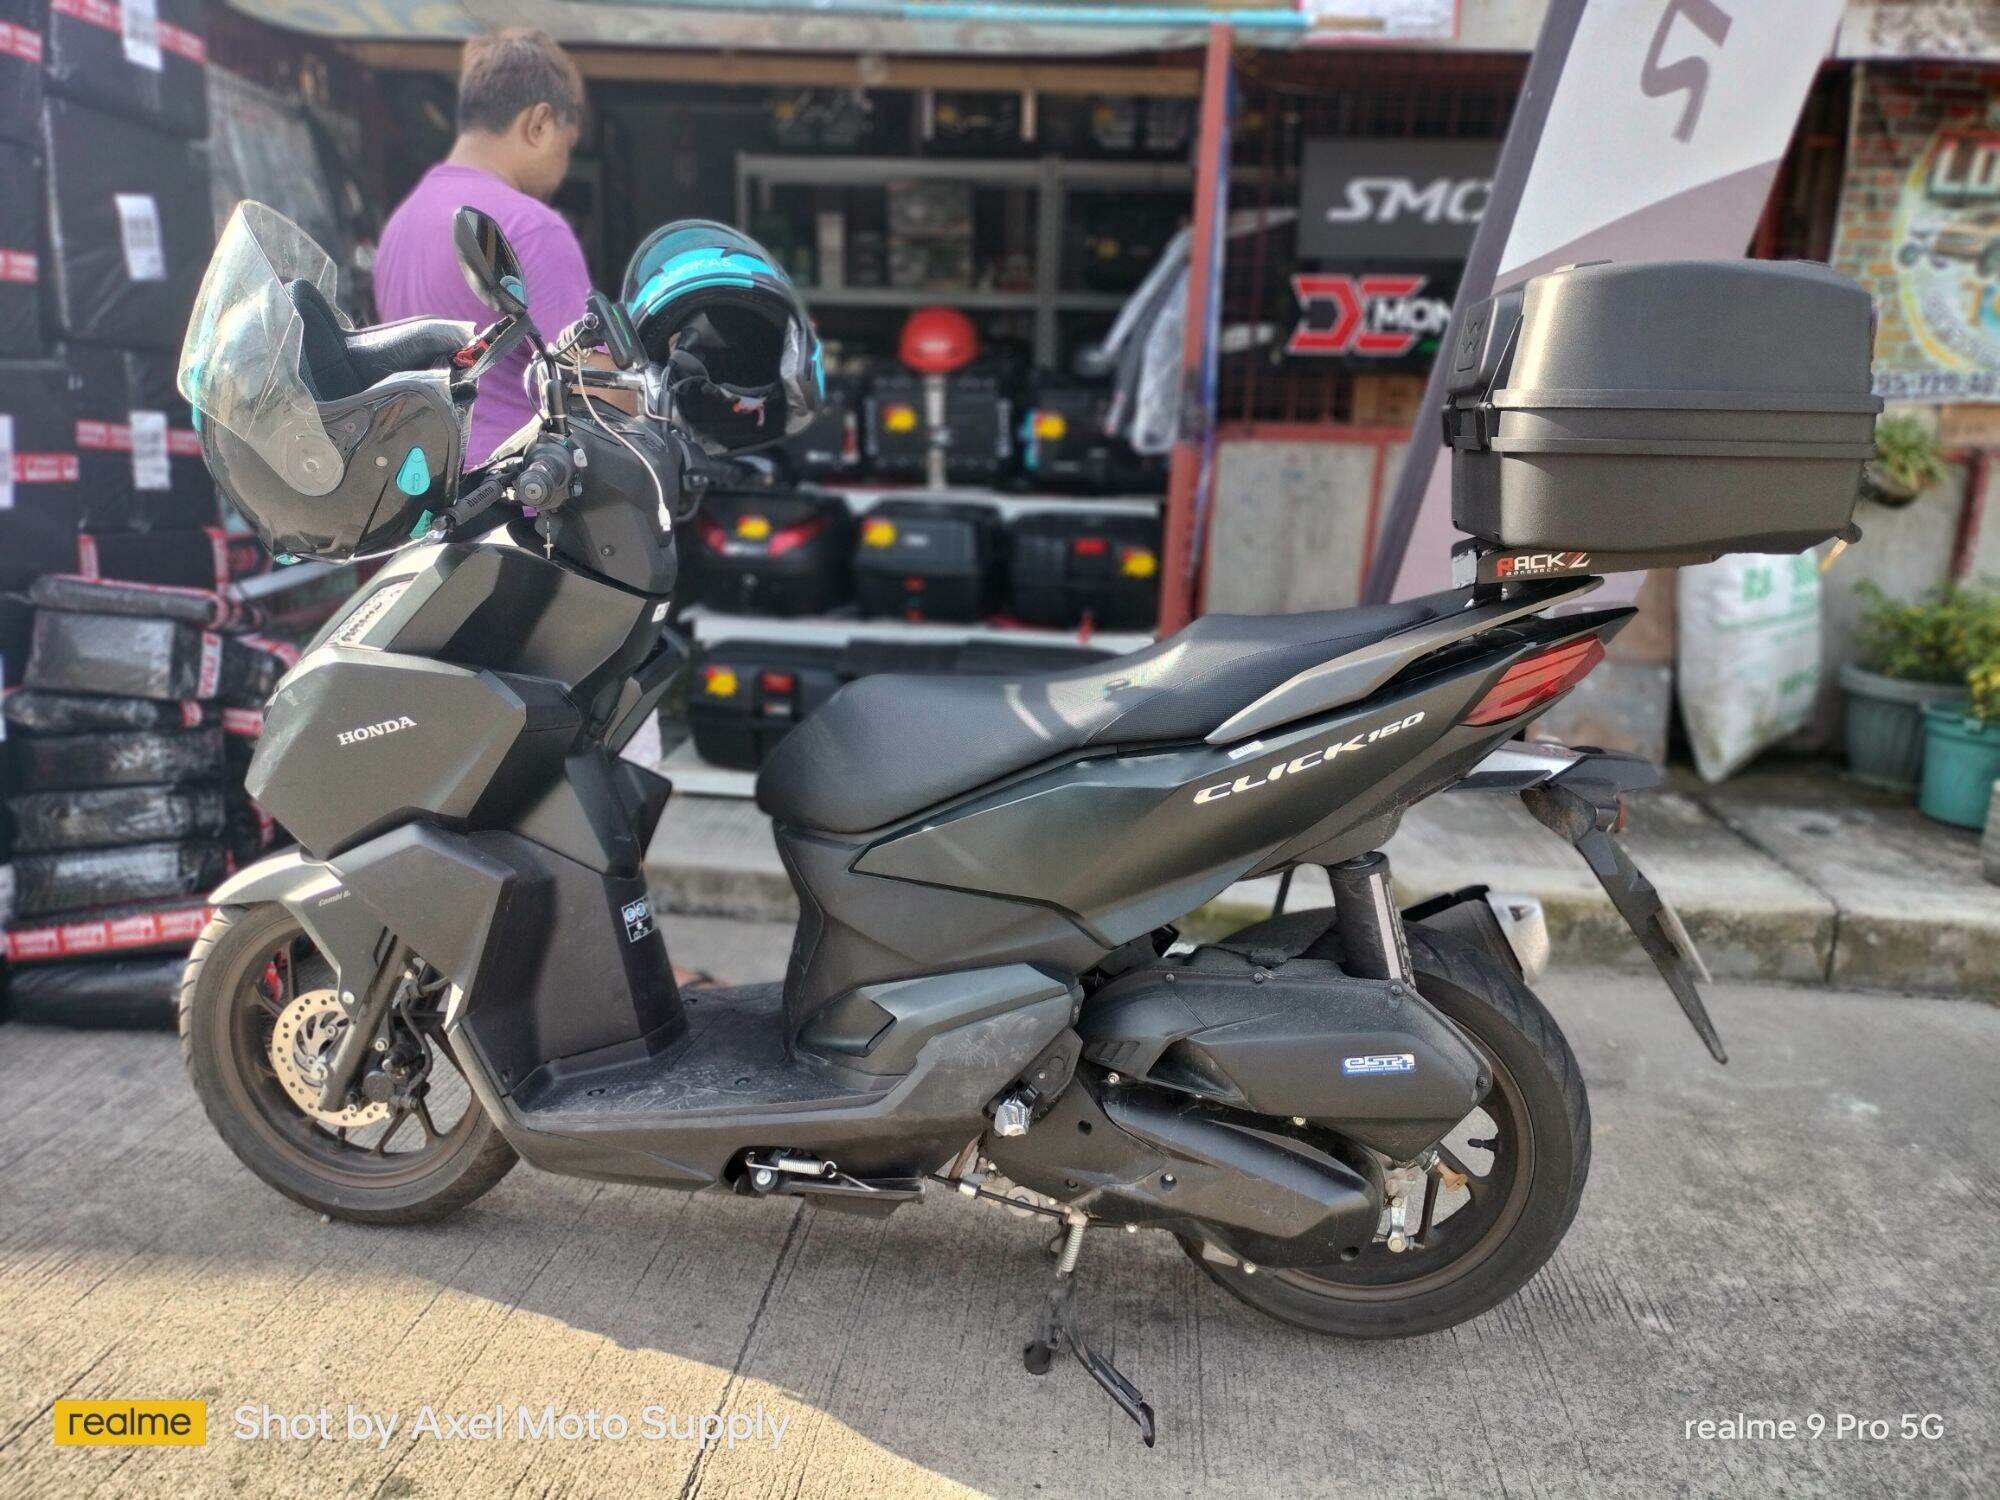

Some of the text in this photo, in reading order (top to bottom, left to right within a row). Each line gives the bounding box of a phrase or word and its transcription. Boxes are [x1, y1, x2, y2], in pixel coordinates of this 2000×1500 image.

[336, 716, 418, 746] HONDA
[1193, 711, 1426, 804] CLICK 160
